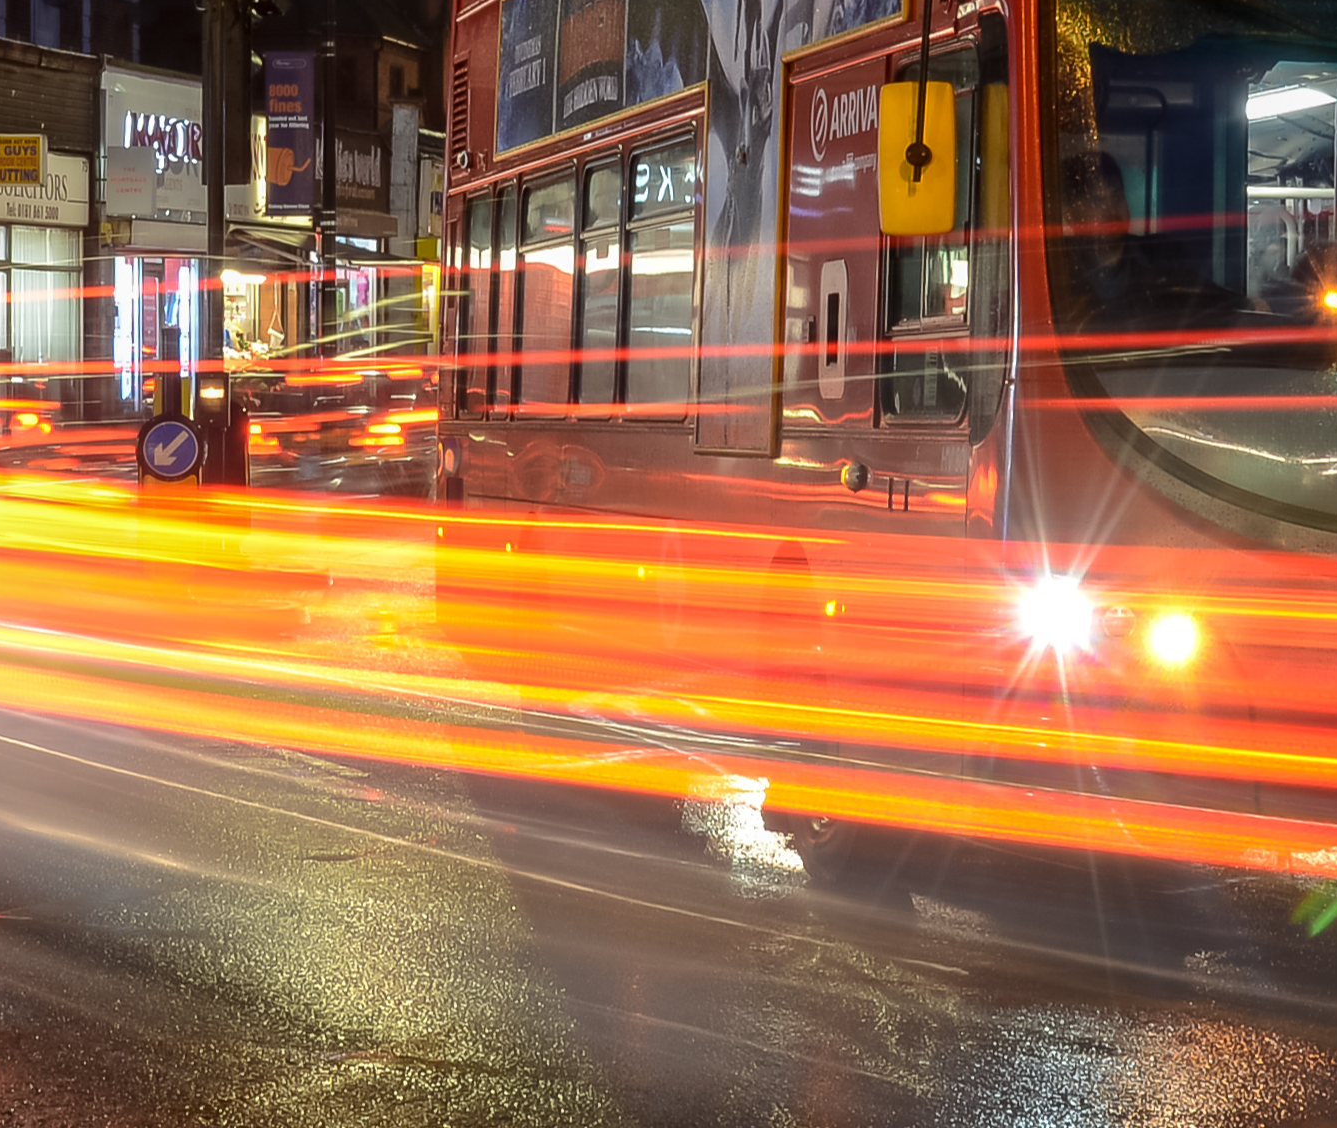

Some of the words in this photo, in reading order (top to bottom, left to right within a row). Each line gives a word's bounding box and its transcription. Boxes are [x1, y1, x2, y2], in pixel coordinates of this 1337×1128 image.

[268, 84, 299, 97] 8000
[268, 98, 302, 113] fines
[829, 84, 878, 141] ARRIVA
[4, 145, 37, 156] GUYS
[16, 157, 37, 167] CENTRE
